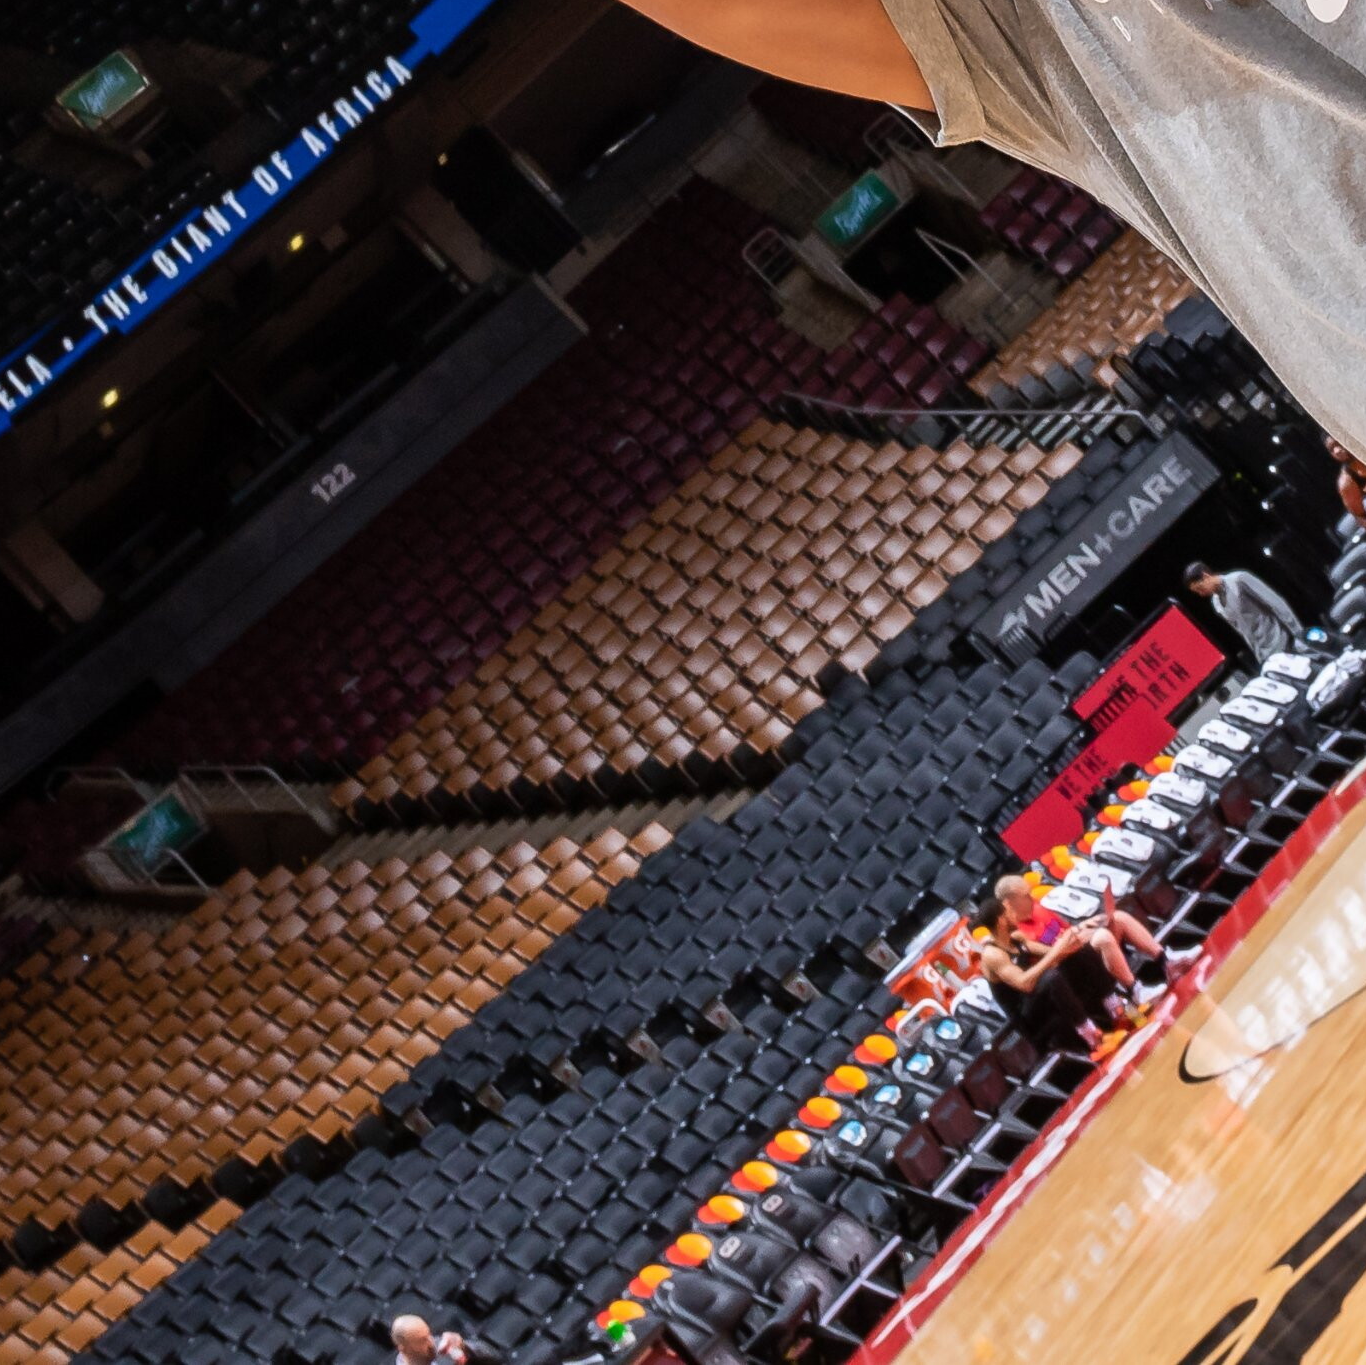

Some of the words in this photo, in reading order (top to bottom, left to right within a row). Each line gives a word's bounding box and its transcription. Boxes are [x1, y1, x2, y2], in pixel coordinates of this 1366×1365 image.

[82, 273, 149, 335] THE
[151, 188, 248, 280] GIANT
[251, 150, 294, 197] OF
[300, 54, 413, 159] AFRICA
[311, 463, 357, 505] 122
[1023, 453, 1193, 619] MEN+CARE
